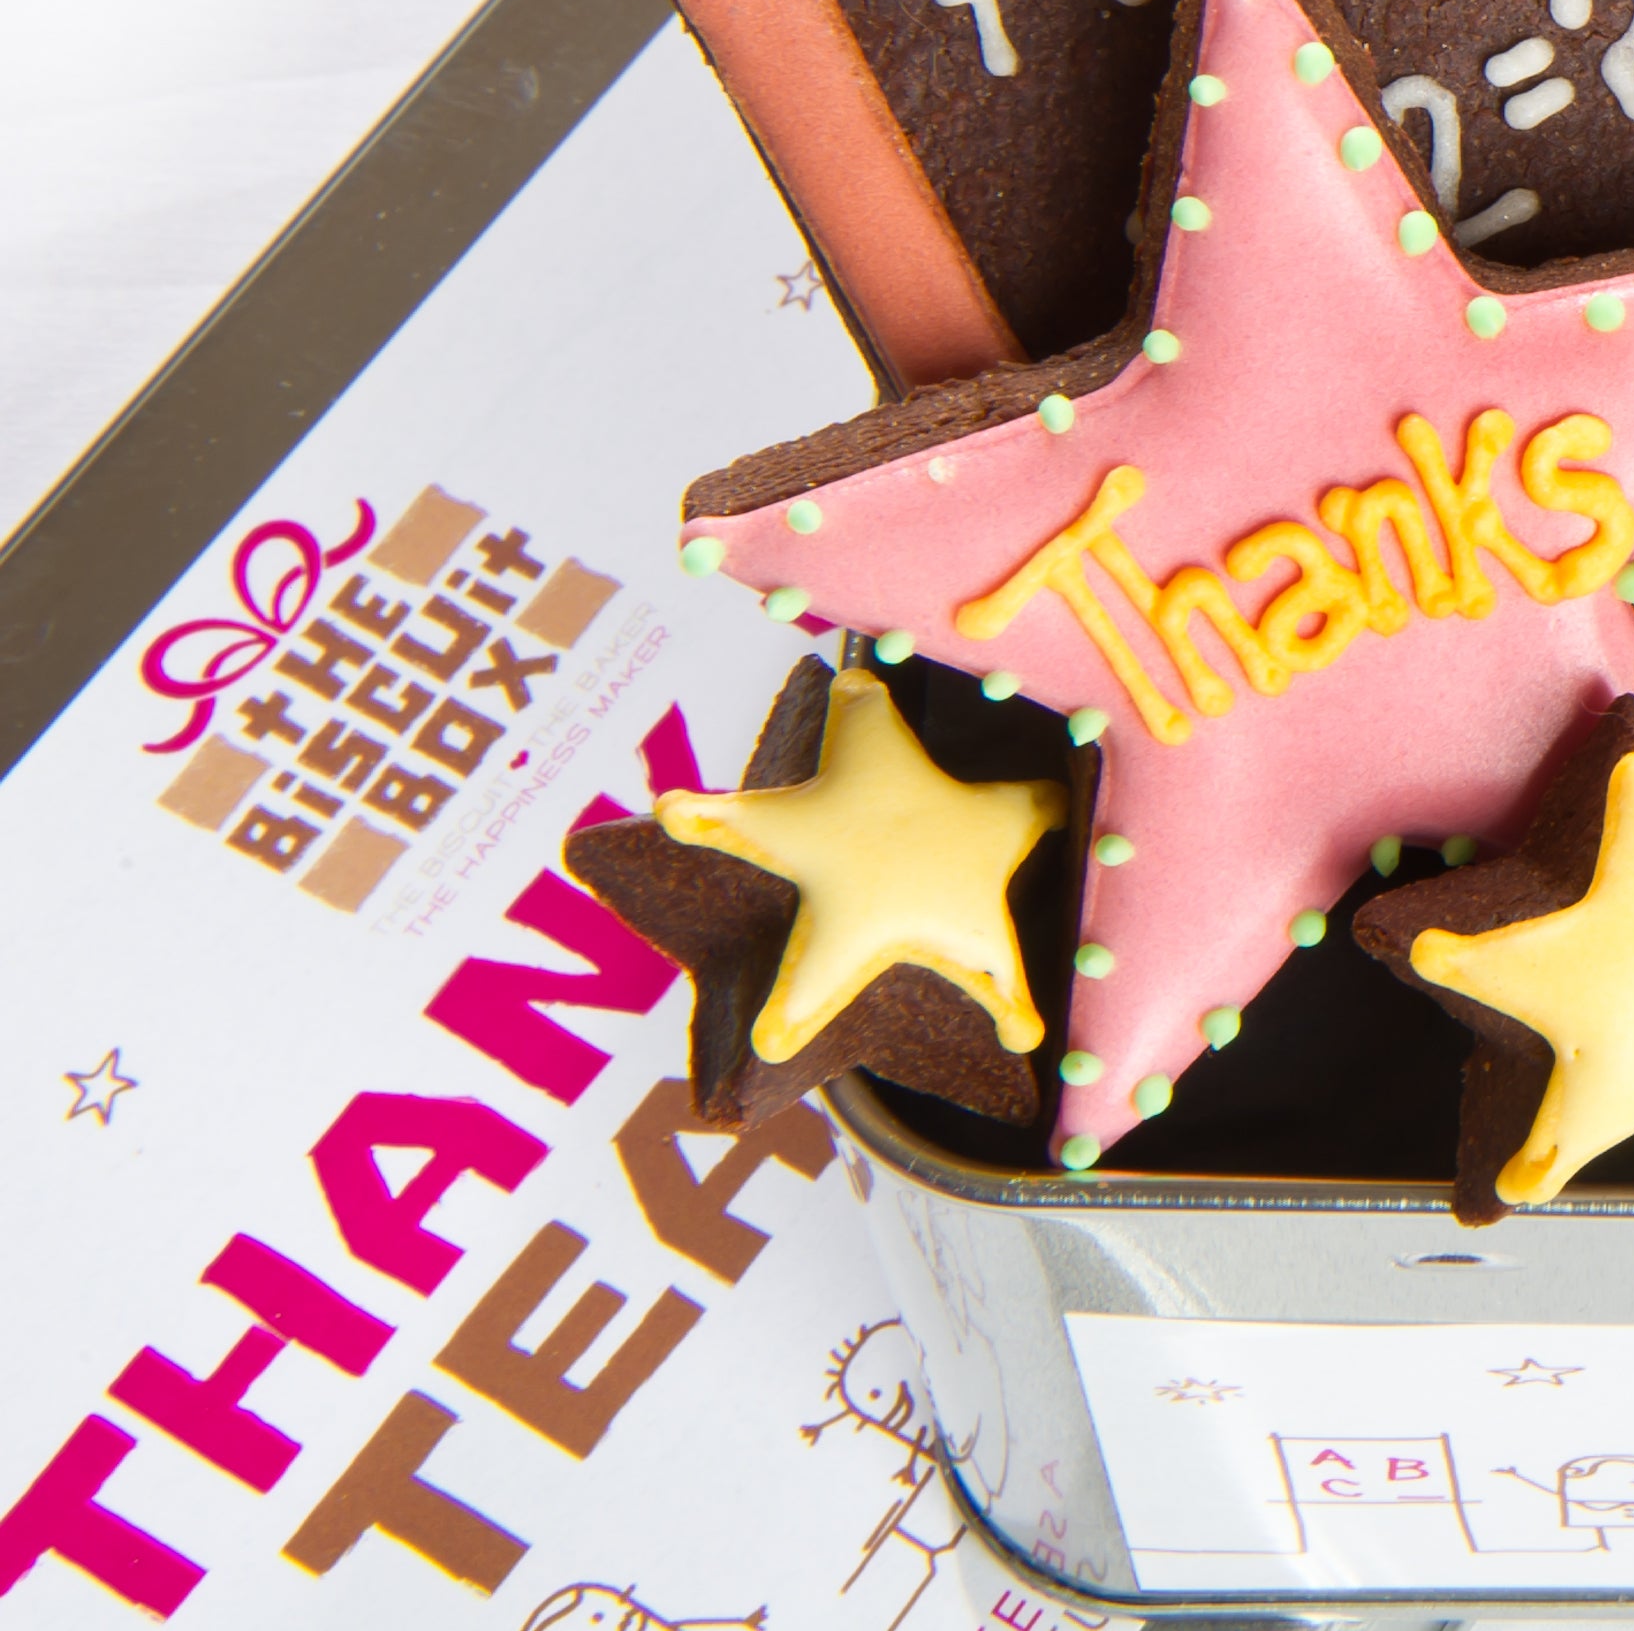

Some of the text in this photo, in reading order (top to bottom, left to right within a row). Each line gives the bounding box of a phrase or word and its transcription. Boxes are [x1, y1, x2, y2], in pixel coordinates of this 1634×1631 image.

[361, 636, 559, 831] BOX
[370, 600, 659, 936] THE BISCUIT THE BAKER
[403, 624, 671, 937] THE HAPPINESS MAKER
[1310, 1449, 1430, 1481] A B
